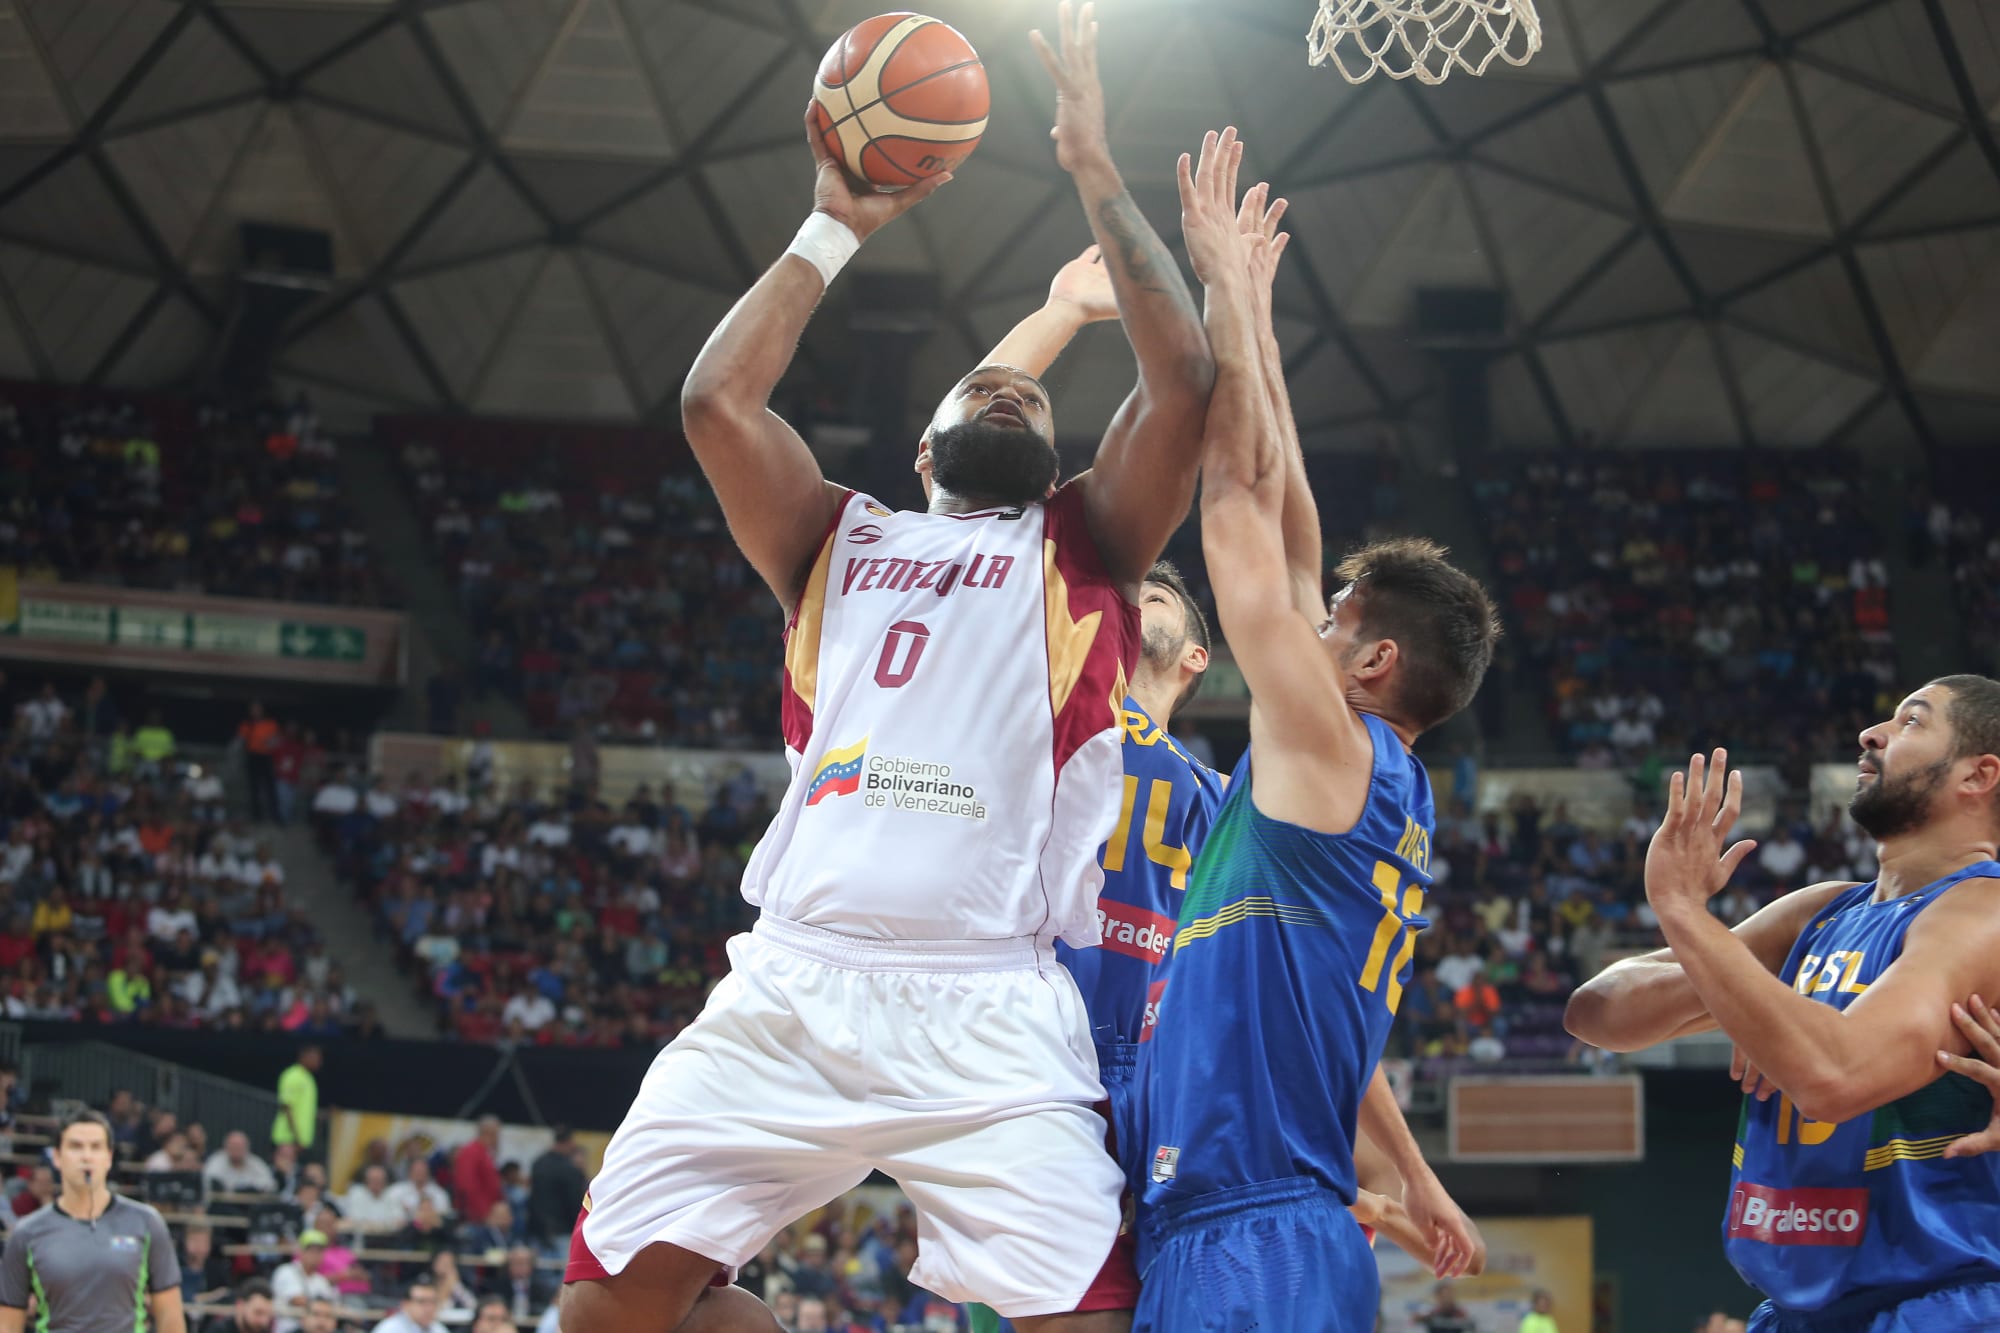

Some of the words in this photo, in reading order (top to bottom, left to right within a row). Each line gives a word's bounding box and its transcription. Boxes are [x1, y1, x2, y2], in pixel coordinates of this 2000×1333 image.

[842, 553, 1015, 597] VENEZULA
[874, 620, 930, 688] 0
[869, 756, 950, 777] Gobierno
[867, 773, 974, 798] Bolivariano
[865, 791, 886, 807] de
[893, 792, 985, 818] Venezuela
[1103, 774, 1191, 891] 14
